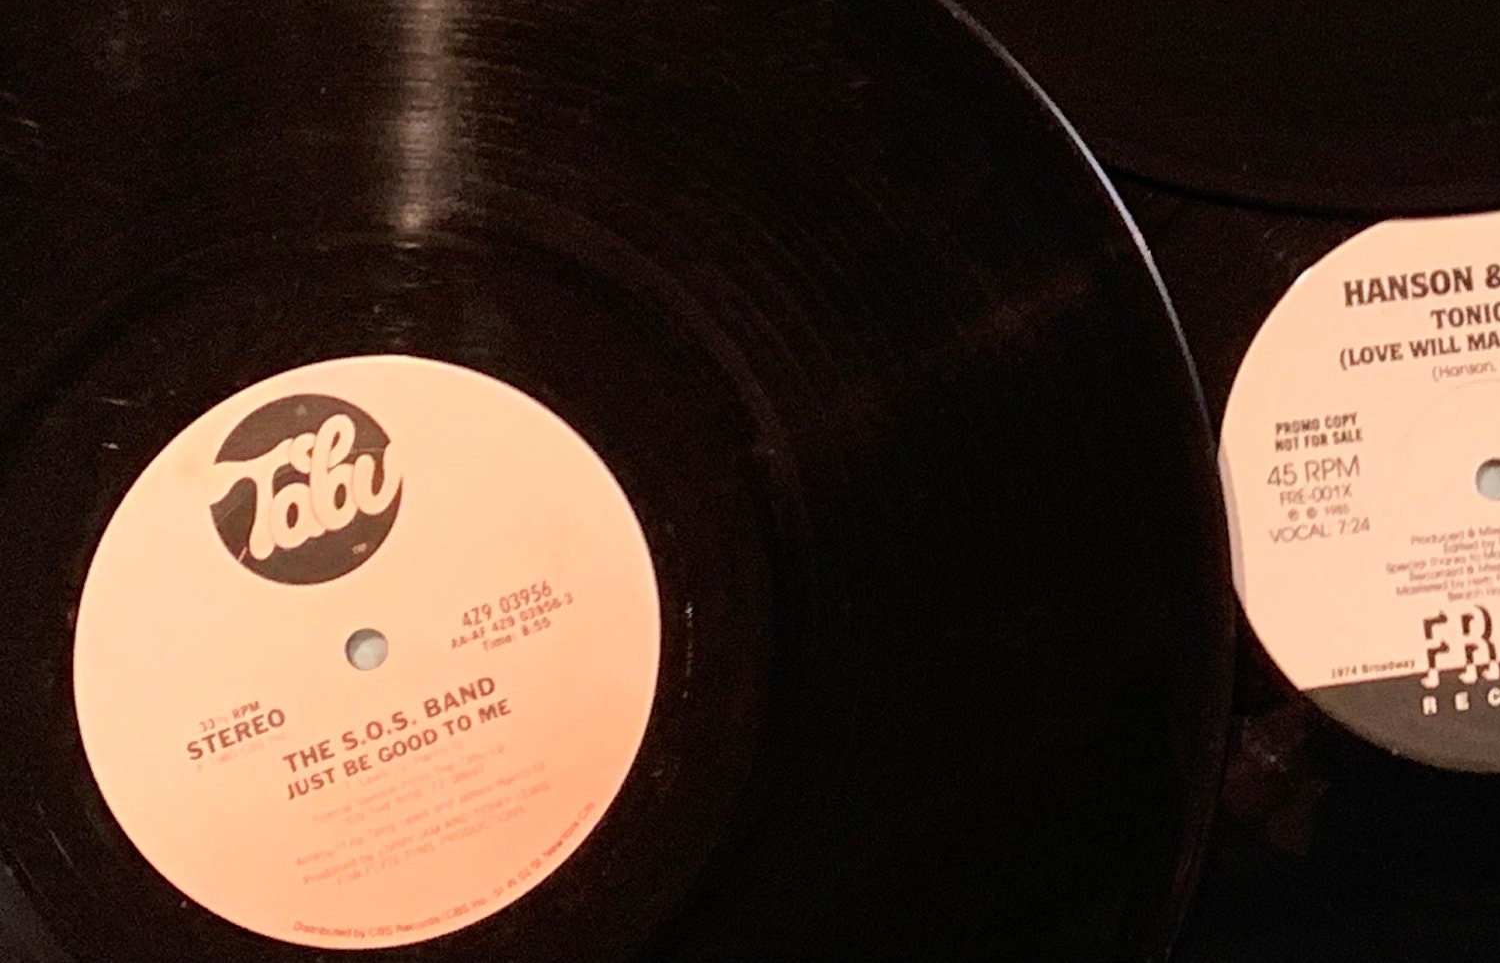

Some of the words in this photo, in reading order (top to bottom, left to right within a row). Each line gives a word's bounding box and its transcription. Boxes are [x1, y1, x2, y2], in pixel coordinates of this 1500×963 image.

[1343, 265, 1474, 308] HANSON
[1339, 342, 1403, 371] (LOVE
[1408, 335, 1462, 358] WILL
[1275, 417, 1320, 436] PROMO
[1324, 411, 1358, 429] COPY
[1275, 436, 1299, 452] NOT
[1304, 432, 1329, 449] FOR
[1332, 427, 1363, 445] SALE
[210, 413, 402, 561] Tabu
[1267, 462, 1298, 487] 45
[1304, 453, 1360, 484] RPM
[1279, 482, 1353, 507] FRE-001X
[499, 579, 552, 614] 03956
[232, 700, 261, 720] RPM
[282, 739, 336, 773] THE
[341, 710, 418, 752] S.O.S.
[422, 676, 496, 719] BAND
[186, 708, 286, 760] STEREO
[286, 767, 336, 800] JUST
[343, 753, 373, 777] BE
[377, 728, 438, 763] GOOD
[442, 715, 473, 737] TO
[477, 698, 512, 724] ME
